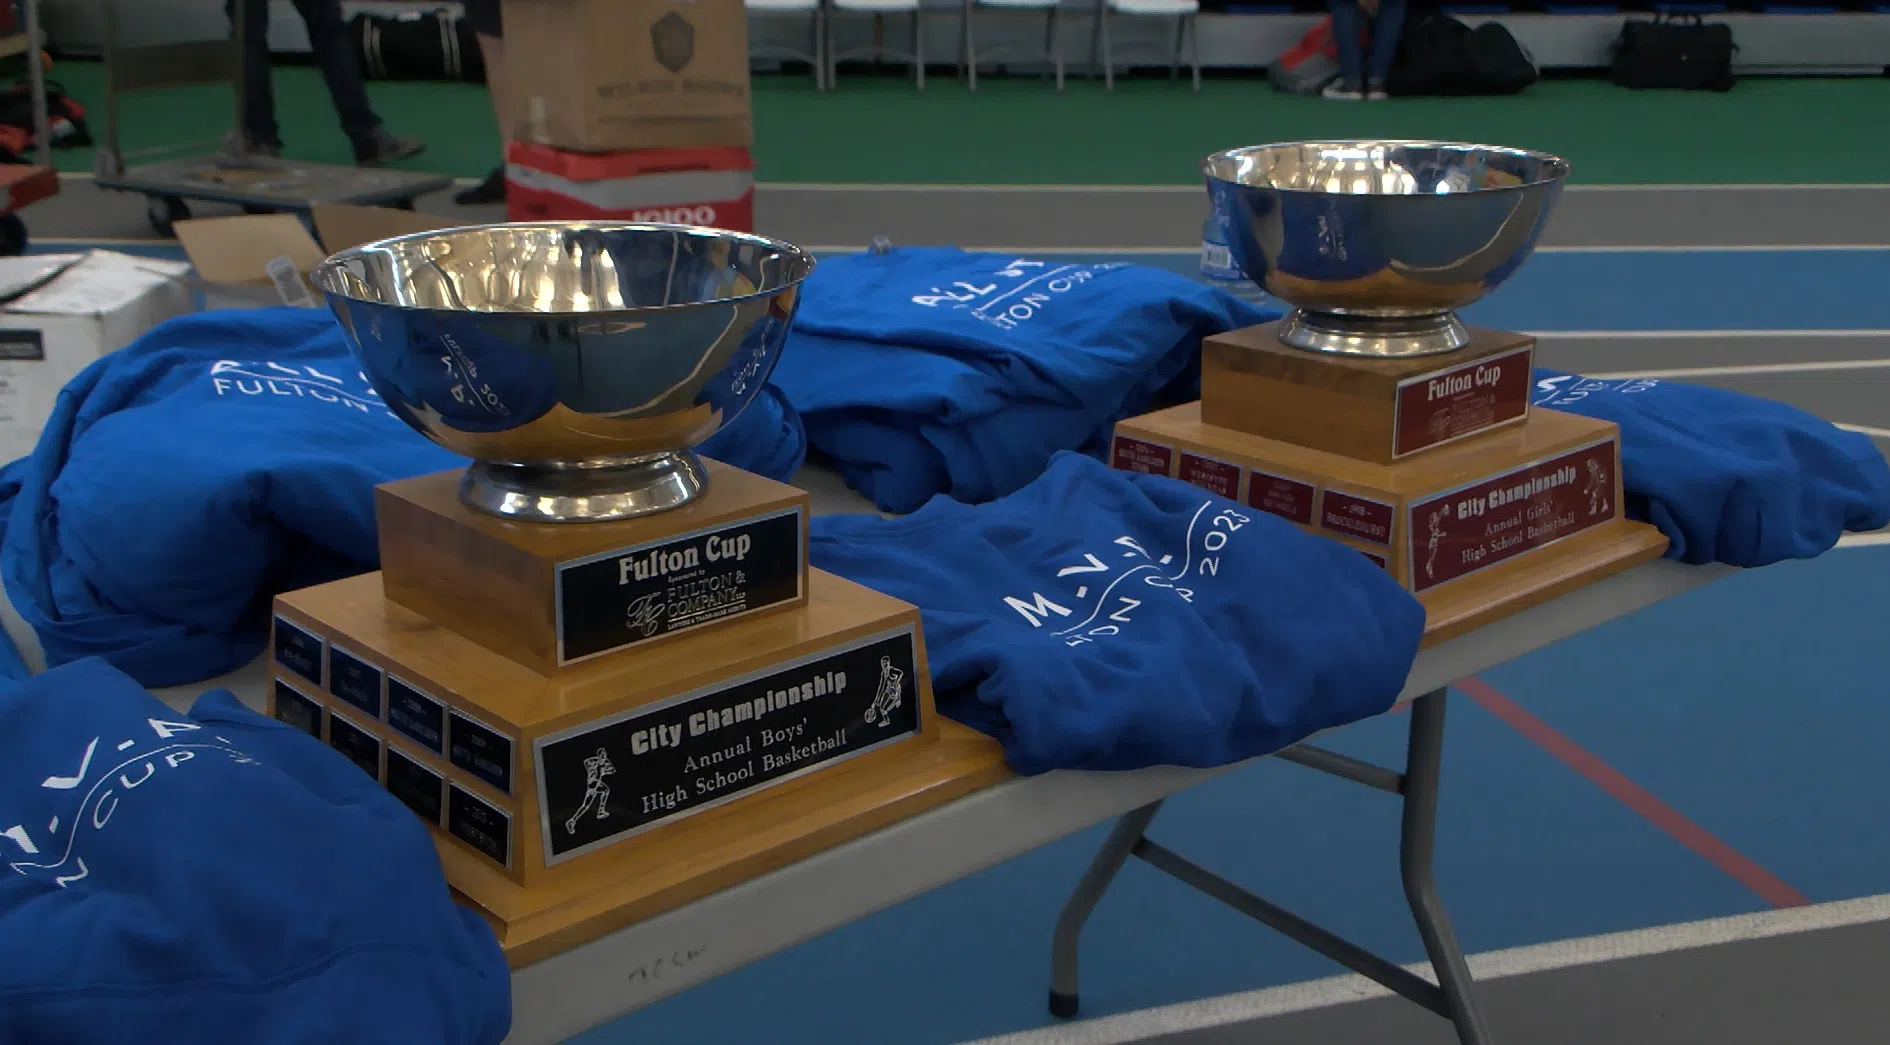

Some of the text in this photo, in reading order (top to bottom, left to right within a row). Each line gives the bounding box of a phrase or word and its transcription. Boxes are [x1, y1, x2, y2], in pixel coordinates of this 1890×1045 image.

[1427, 365, 1501, 401] Fulton Cup
[1457, 466, 1577, 520] City Championship
[1461, 512, 1576, 564] High School Basketball
[1484, 512, 1522, 537] Annual
[618, 533, 752, 585] Fulton Cup
[667, 570, 746, 603] FULTON &
[667, 586, 738, 617] COMPANY
[630, 671, 847, 756] City Championship
[641, 728, 848, 815] High School Basketball
[684, 717, 808, 774] Annual Boys'
